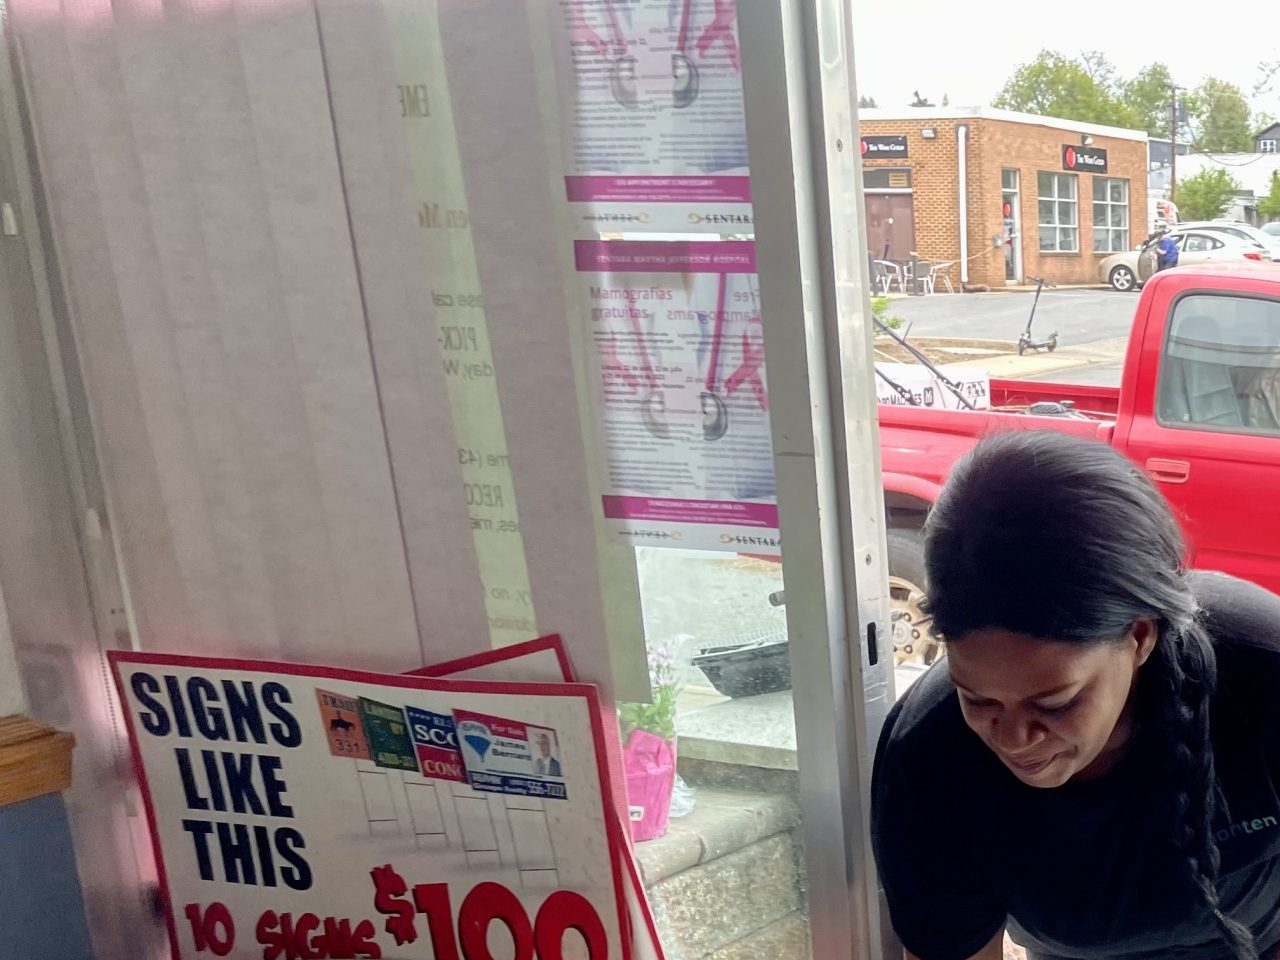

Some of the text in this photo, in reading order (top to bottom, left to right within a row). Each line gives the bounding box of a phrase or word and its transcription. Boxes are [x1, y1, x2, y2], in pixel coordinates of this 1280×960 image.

[591, 305, 650, 321] gratuitas
[130, 671, 302, 748] SIGNS
[173, 747, 295, 819] LIKE
[182, 819, 313, 891] THIS
[185, 901, 236, 957] 10
